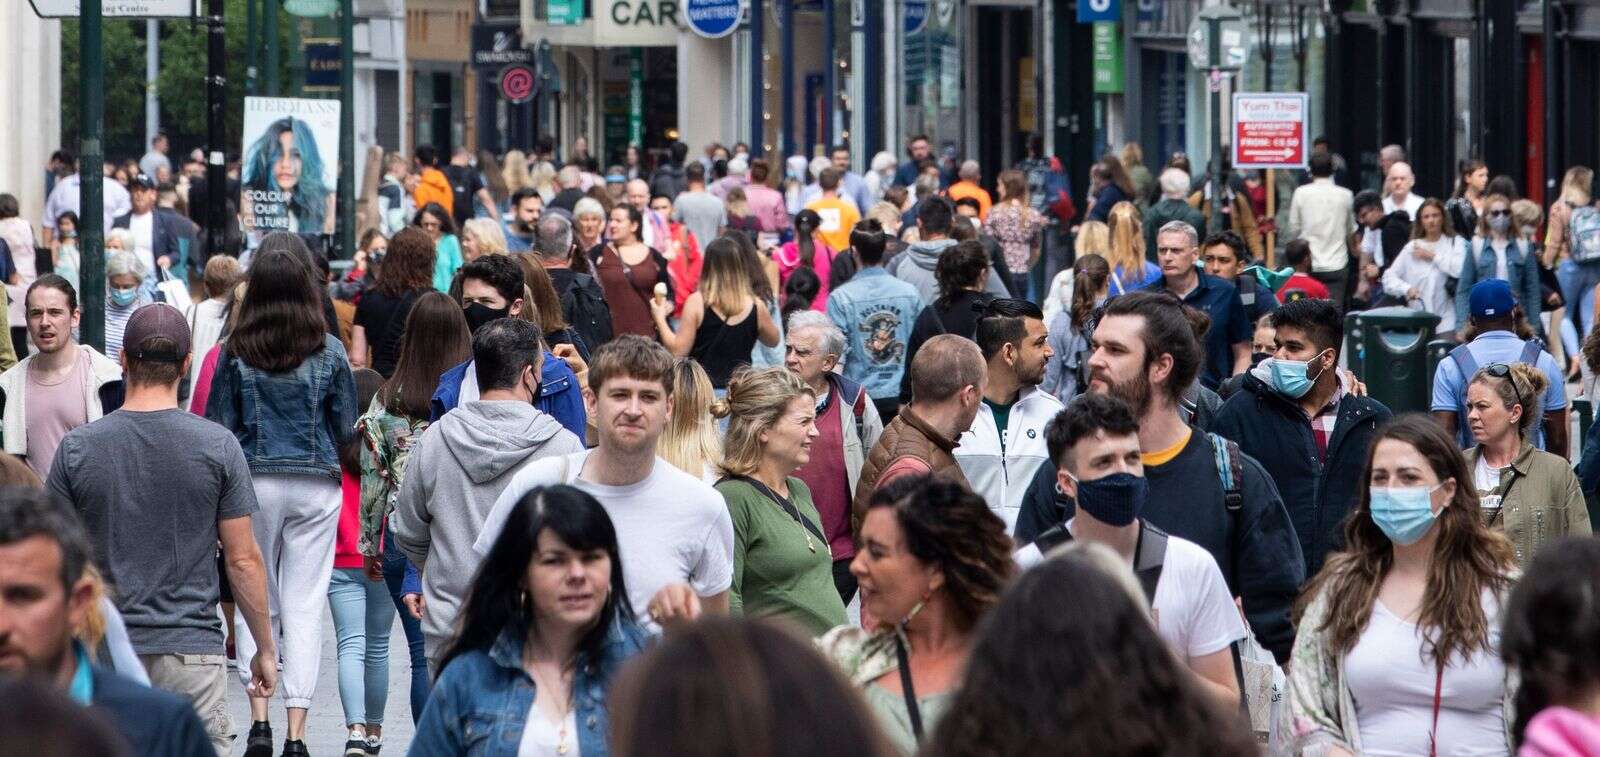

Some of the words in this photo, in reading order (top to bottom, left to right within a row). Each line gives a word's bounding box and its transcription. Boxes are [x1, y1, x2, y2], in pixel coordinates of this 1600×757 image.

[249, 100, 337, 112] HERMANS
[1242, 100, 1270, 111] Yum
[245, 190, 292, 203] COLOUR
[255, 203, 279, 215] OUR
[243, 216, 289, 228] CULTURE
